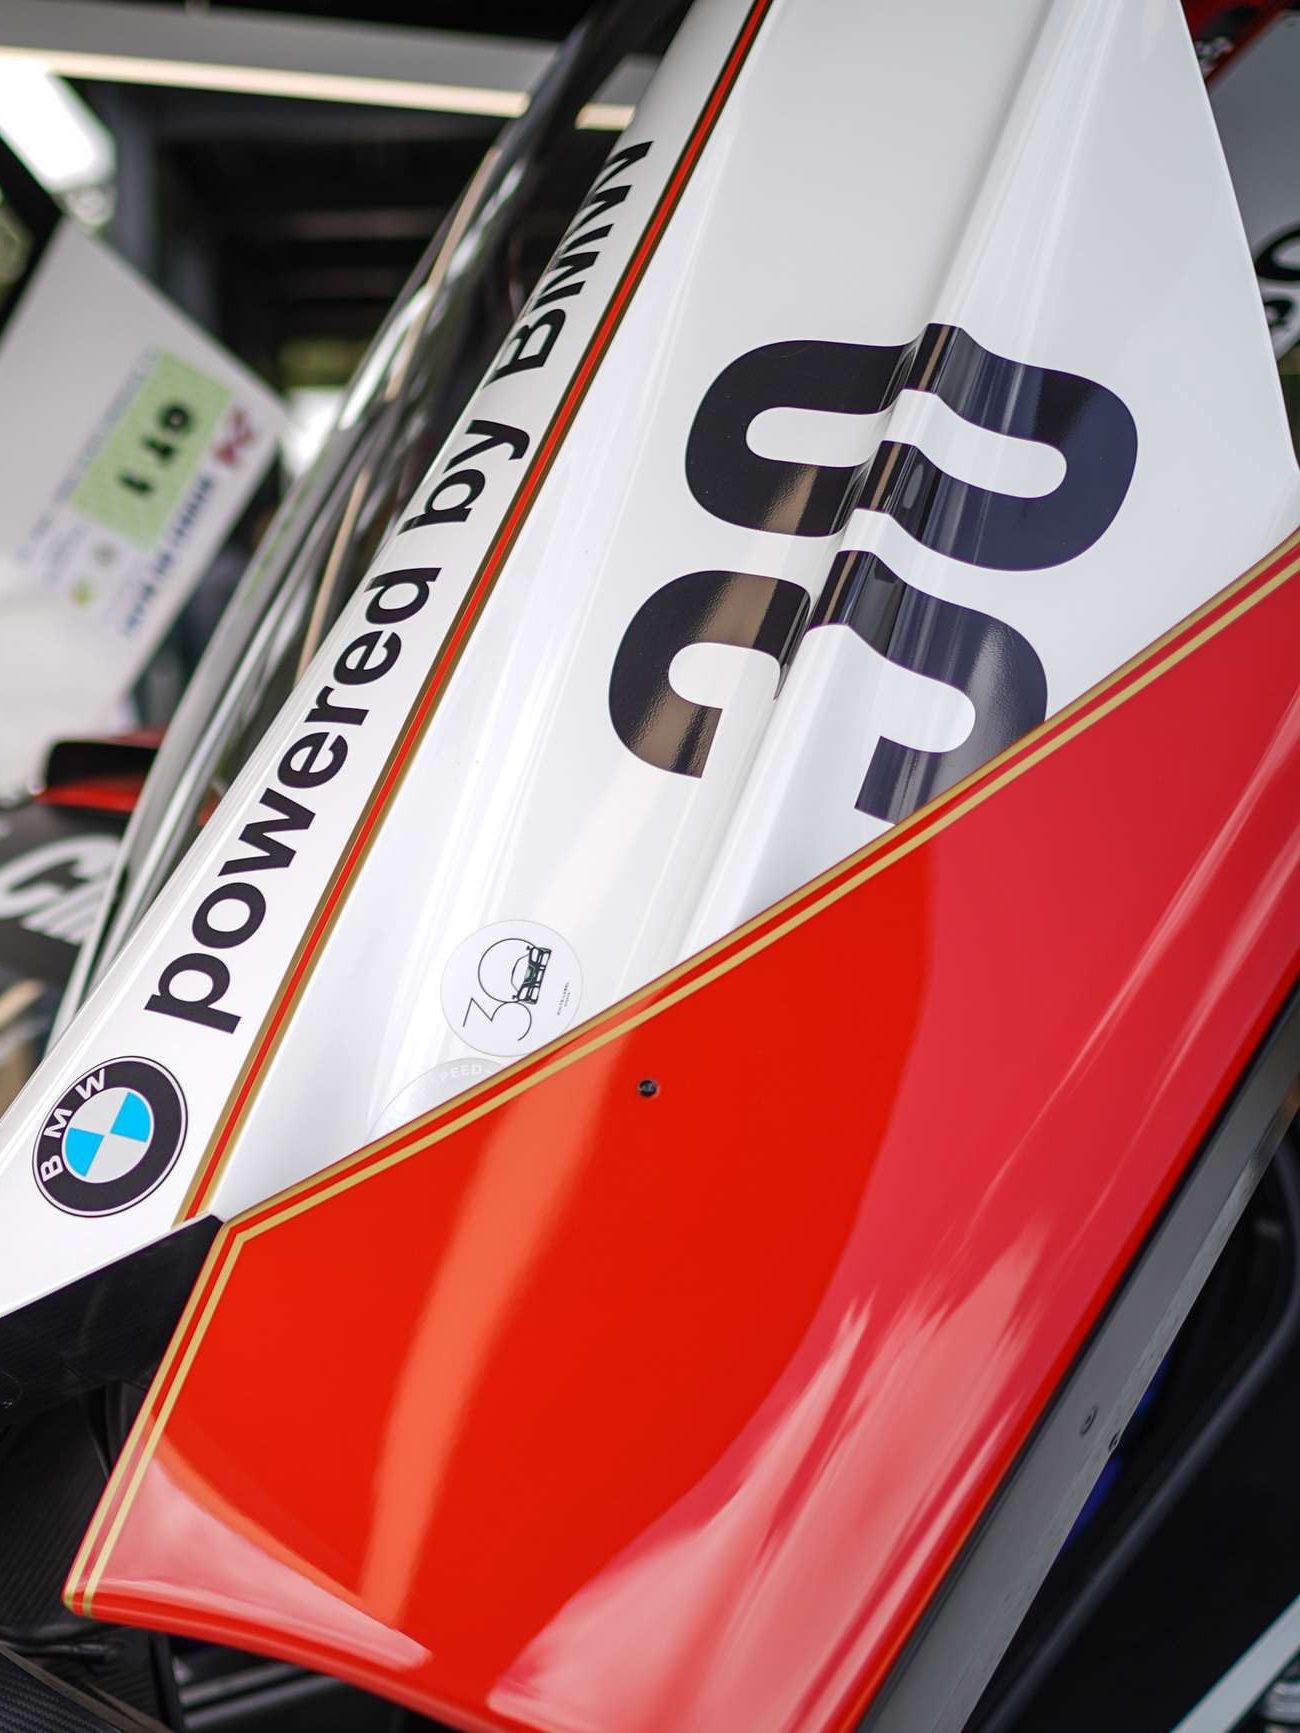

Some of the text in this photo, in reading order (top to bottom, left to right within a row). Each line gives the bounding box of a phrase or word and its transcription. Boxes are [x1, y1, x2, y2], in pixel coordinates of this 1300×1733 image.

[144, 567, 442, 1035] powered
[397, 419, 531, 536] by
[483, 140, 654, 388] BMW
[609, 322, 1138, 826] 30
[40, 1068, 106, 1183] BMW
